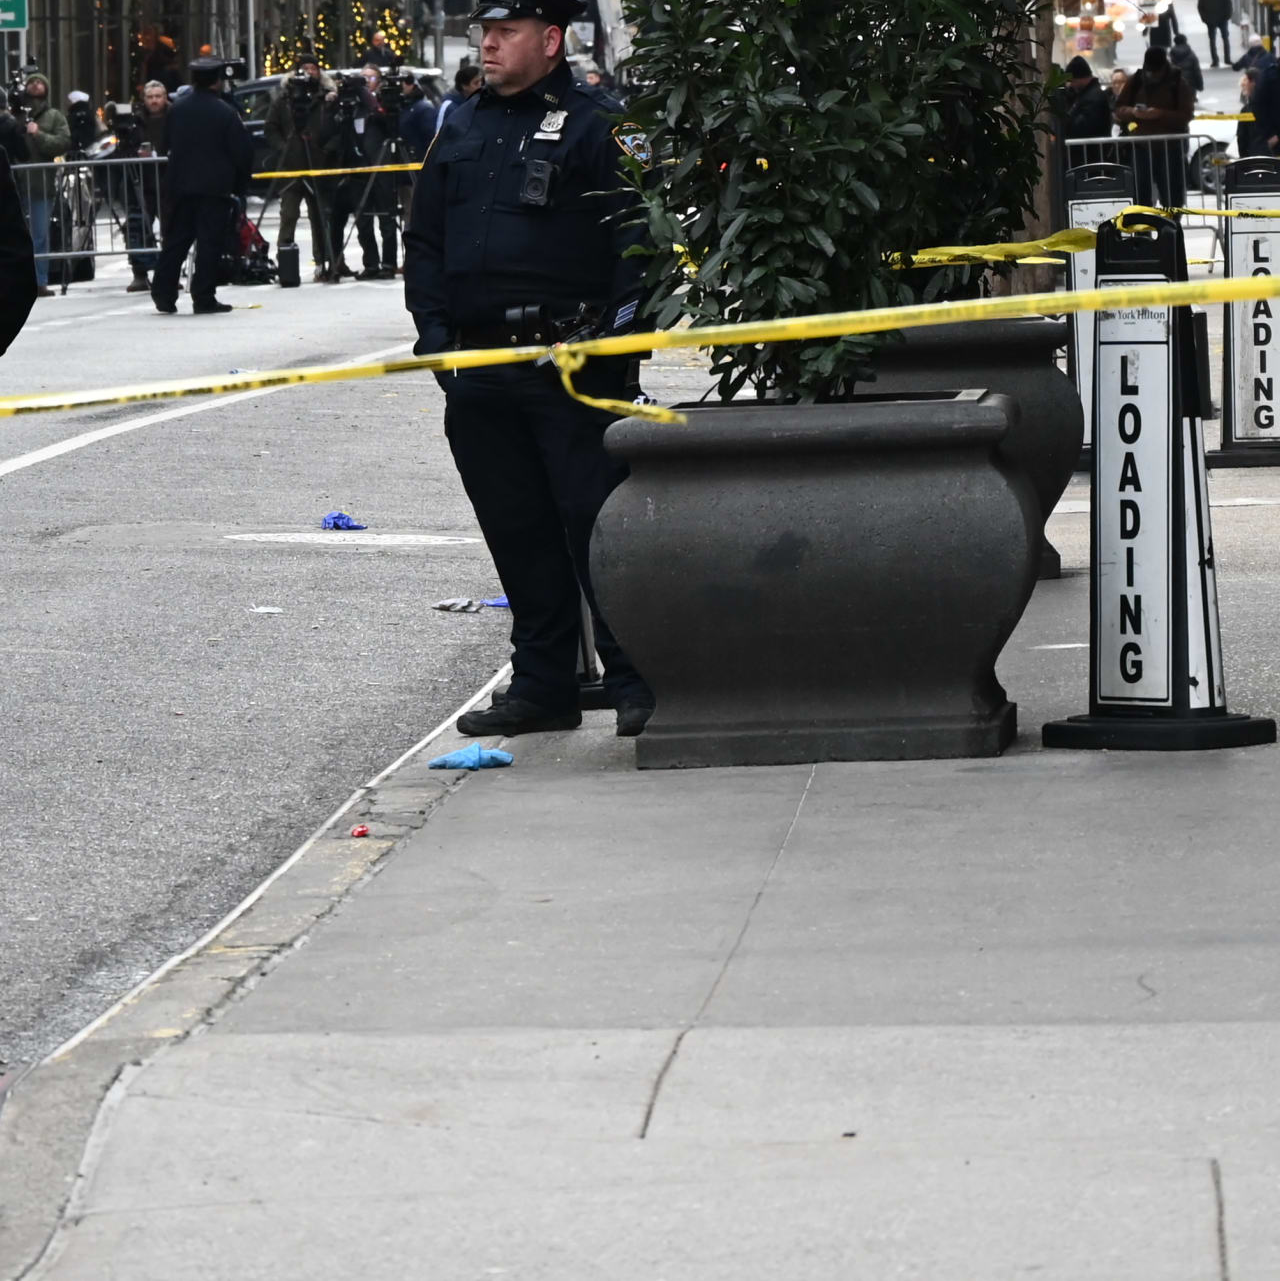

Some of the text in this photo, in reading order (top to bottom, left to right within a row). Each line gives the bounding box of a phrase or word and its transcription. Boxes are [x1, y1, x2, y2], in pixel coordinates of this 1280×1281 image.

[1117, 309, 1136, 319] York
[1136, 307, 1165, 319] Hilton
[1118, 355, 1143, 684] LOADING
